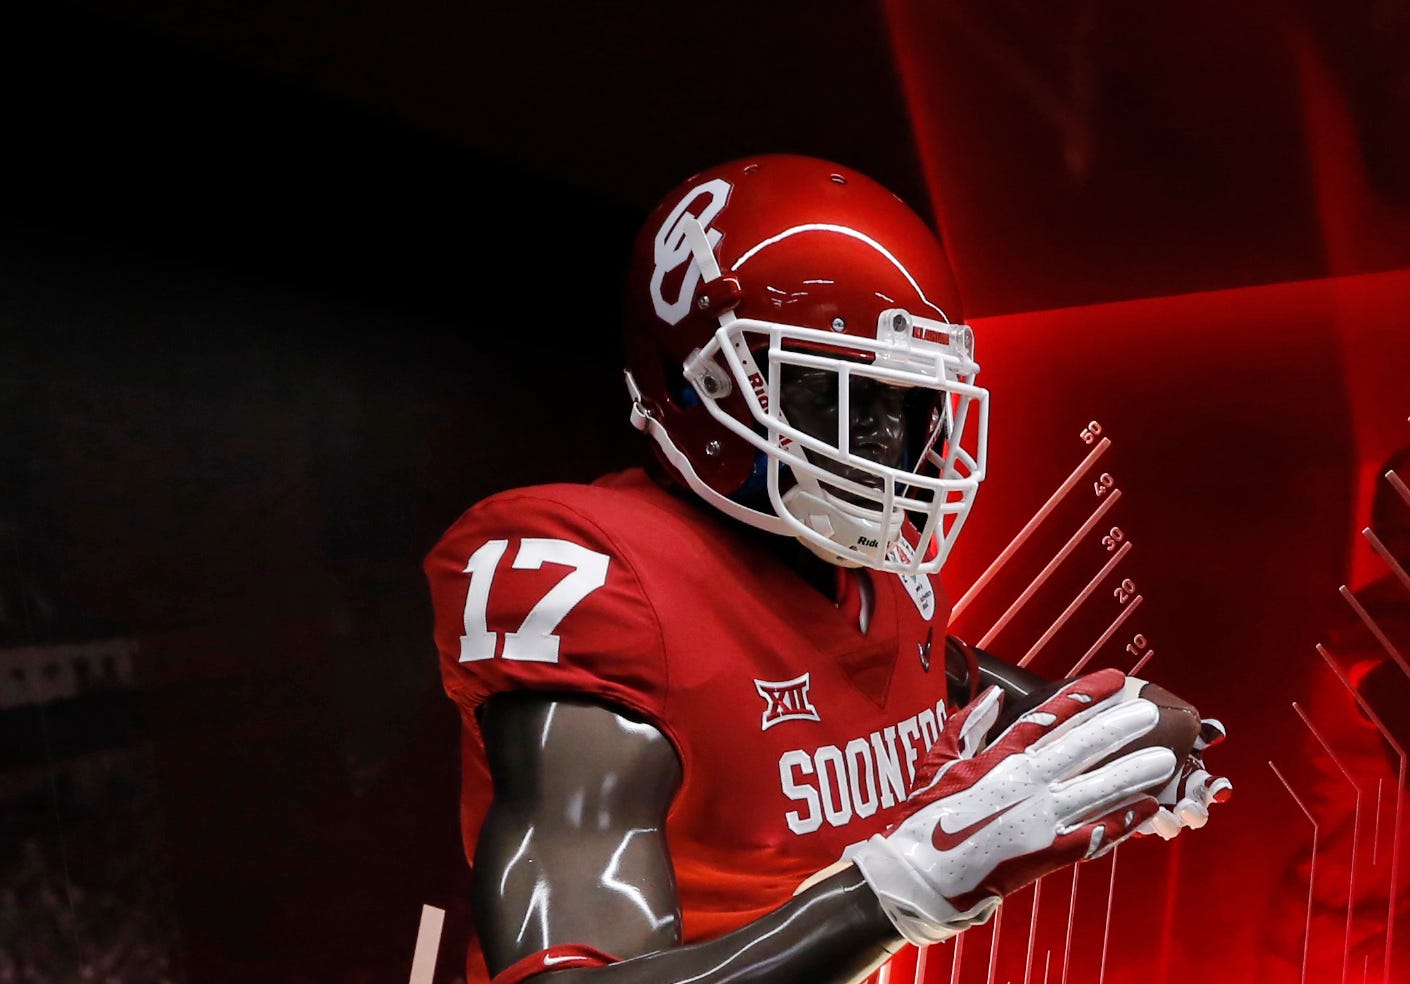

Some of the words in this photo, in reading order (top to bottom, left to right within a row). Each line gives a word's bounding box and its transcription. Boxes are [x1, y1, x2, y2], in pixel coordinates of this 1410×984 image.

[1080, 420, 1102, 445] 50
[1094, 472, 1114, 497] 40
[1102, 526, 1124, 551] 30
[459, 538, 611, 663] 17
[1114, 578, 1136, 604] 20
[1126, 633, 1147, 657] 10
